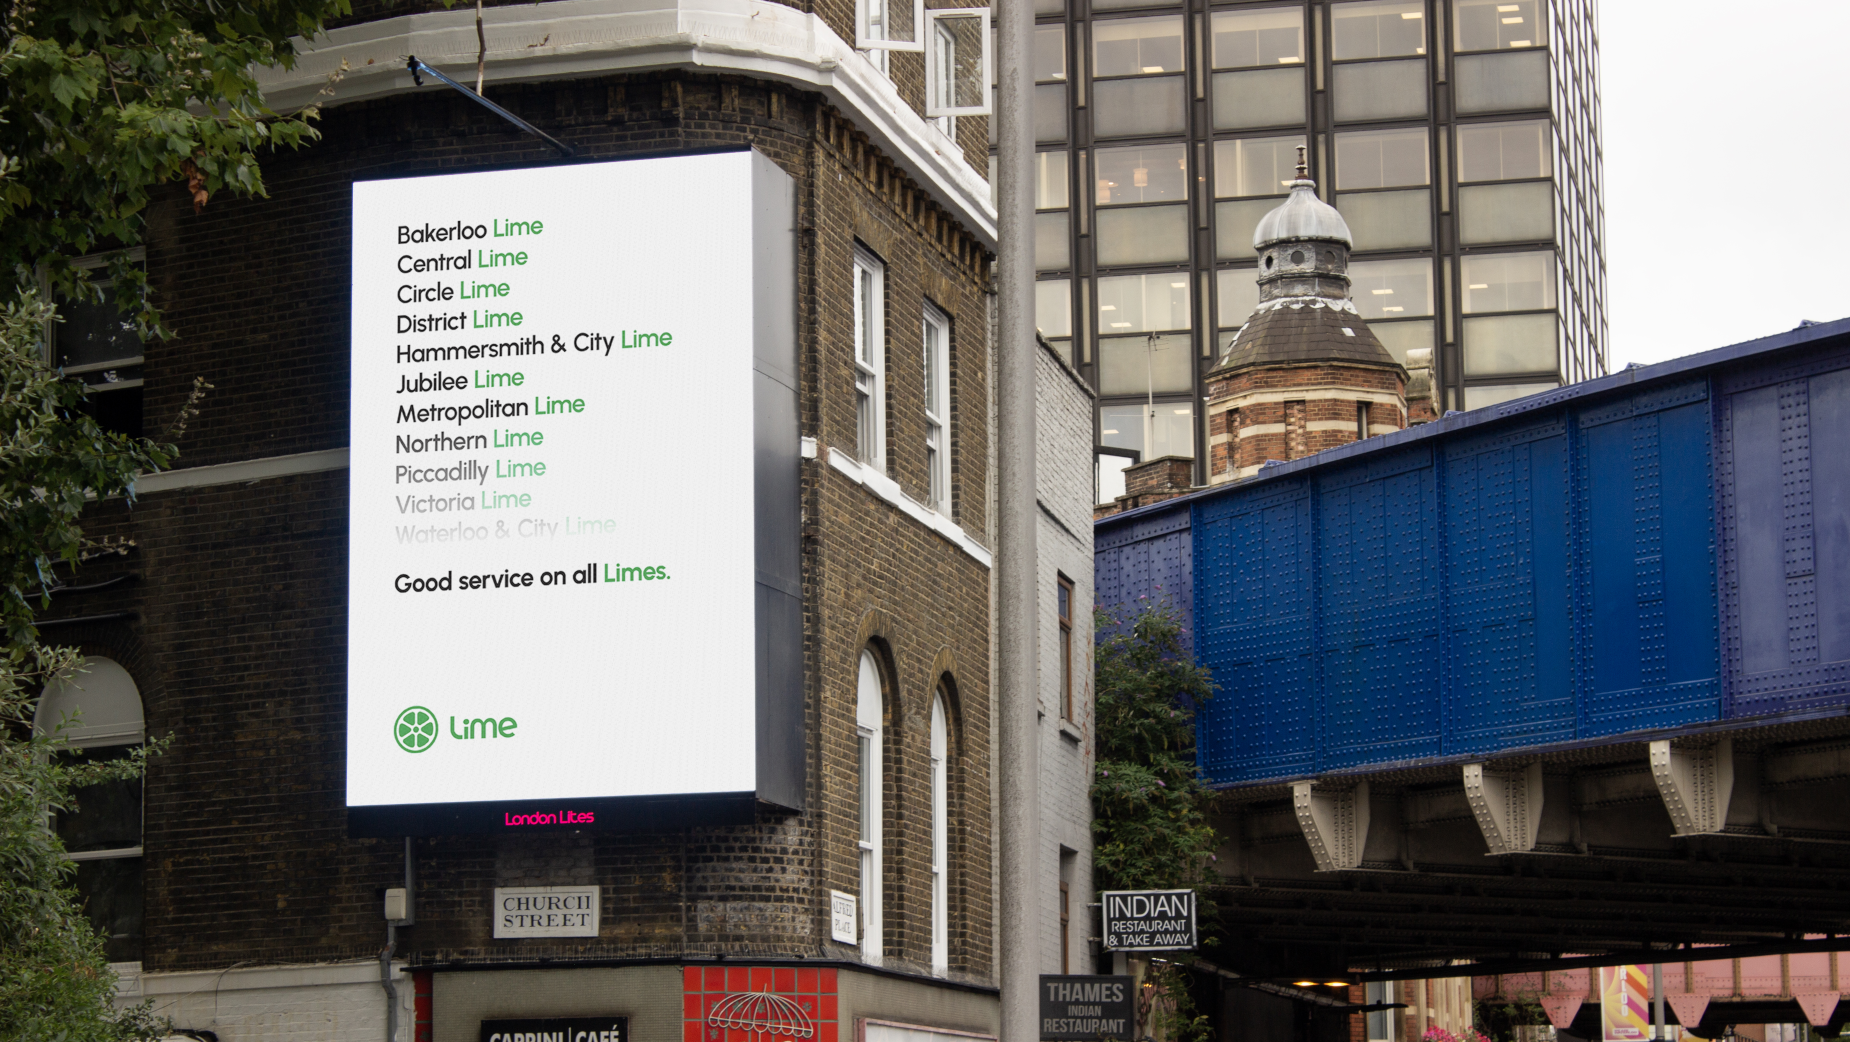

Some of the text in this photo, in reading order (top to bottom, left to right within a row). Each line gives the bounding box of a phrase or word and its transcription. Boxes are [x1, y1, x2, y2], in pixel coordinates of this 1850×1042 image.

[398, 218, 543, 245] Bakerloo Lime
[397, 249, 528, 274] Central Lime
[397, 281, 510, 304] Circle Lime
[397, 309, 523, 334] District Lime
[397, 329, 673, 364] Hammersmith & City Lime
[396, 369, 524, 395] Jubilee Lime
[396, 395, 585, 426] Metropolitan Lime
[396, 429, 544, 454] Northern Lime
[396, 459, 546, 486] Piccadilly Lime
[396, 490, 532, 515] Victoria Lime
[395, 516, 617, 544] Waterloo & City Lime
[394, 563, 671, 593] Good service on all Limes.
[450, 715, 518, 740] Lime
[505, 810, 595, 826] London Lites
[503, 895, 591, 912] CHURCH
[1109, 895, 1188, 918] INDIAN
[503, 913, 590, 928] STREET
[1111, 919, 1187, 933] RESTAURANT
[1108, 933, 1190, 946] & TAKE AWAY
[1046, 982, 1124, 1002] THAMES
[1620, 965, 1628, 1017] RLOO
[1067, 1005, 1102, 1017] INDIAN
[575, 1024, 620, 1042] CAFÉ
[1043, 1018, 1126, 1034] RESTAURANT
